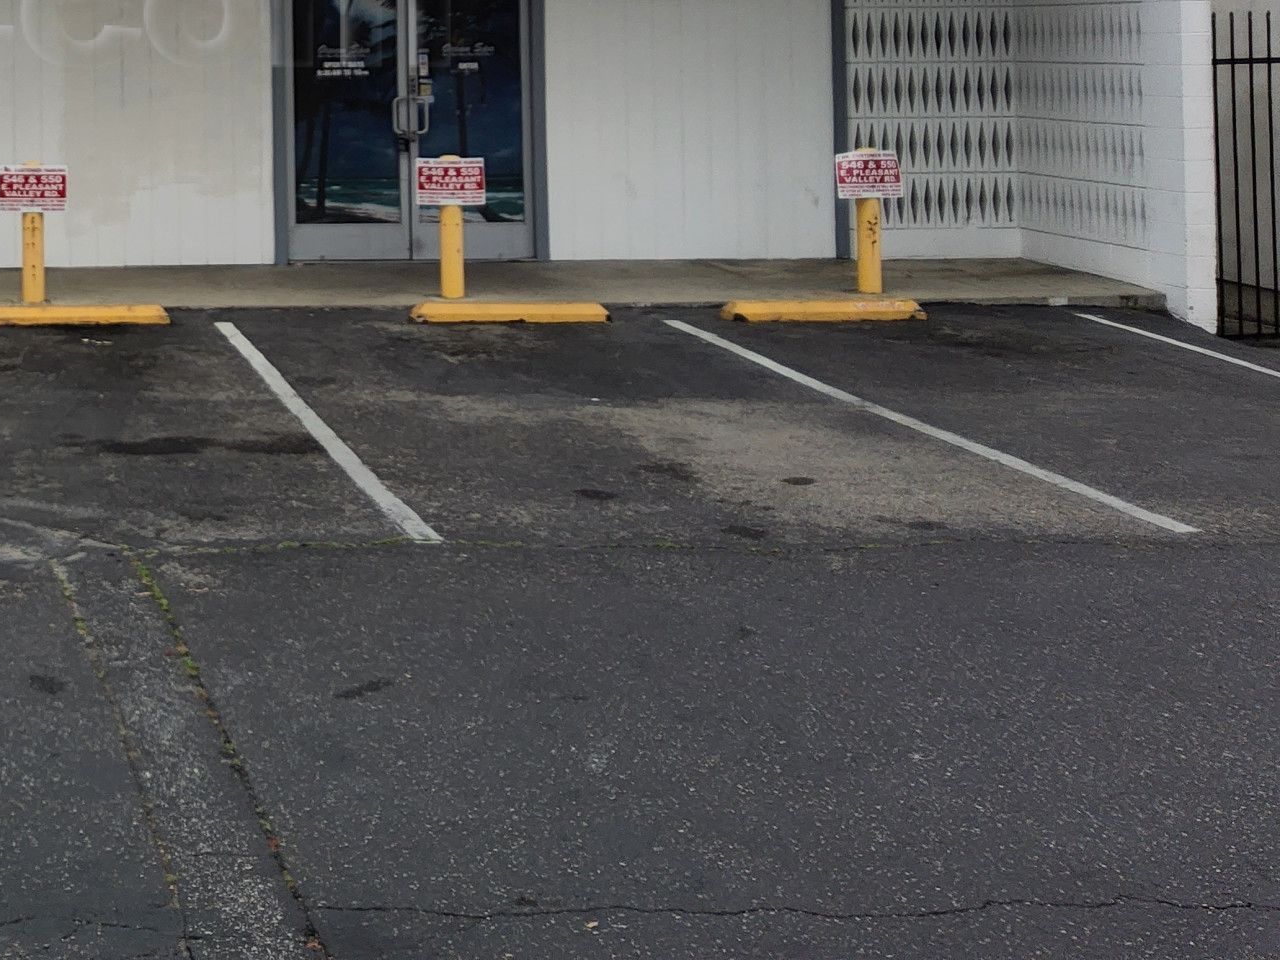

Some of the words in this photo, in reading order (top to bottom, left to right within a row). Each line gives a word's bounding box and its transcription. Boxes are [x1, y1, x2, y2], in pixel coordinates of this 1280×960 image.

[868, 160, 877, 169] &
[447, 167, 458, 176] &
[28, 175, 37, 183] &
